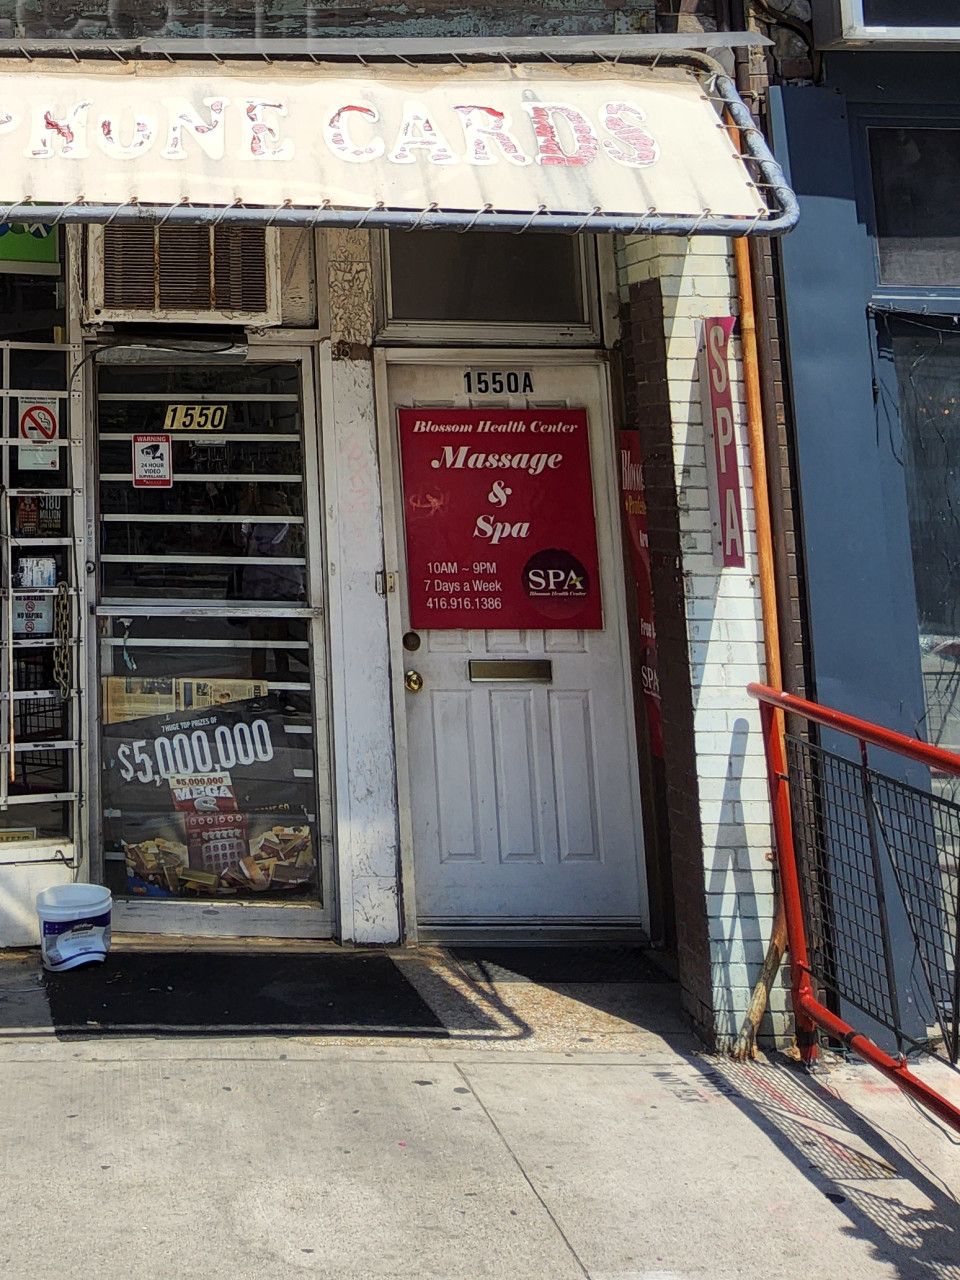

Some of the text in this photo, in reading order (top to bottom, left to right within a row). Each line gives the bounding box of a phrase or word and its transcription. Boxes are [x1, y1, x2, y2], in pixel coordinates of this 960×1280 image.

[321, 99, 661, 169] CARDS
[464, 371, 534, 394] 1550A
[169, 406, 225, 429] 1550
[413, 420, 578, 434] Blossom Health Center
[709, 324, 743, 559] SPA
[431, 445, 563, 476] Massage
[487, 480, 512, 507] &
[472, 514, 531, 545] Spa
[427, 562, 457, 574] 10AM
[472, 562, 497, 574] 9PM
[424, 580, 503, 593] 7 Days a Week
[528, 569, 585, 590] SPA
[426, 597, 502, 611] 416.916.1386
[166, 722, 179, 732] HUGE
[180, 720, 191, 730] TOP
[191, 718, 210, 728] PRIZES
[117, 719, 274, 787] $5,000,000
[176, 776, 224, 786] $5,000,000
[173, 786, 233, 801] MEGA
